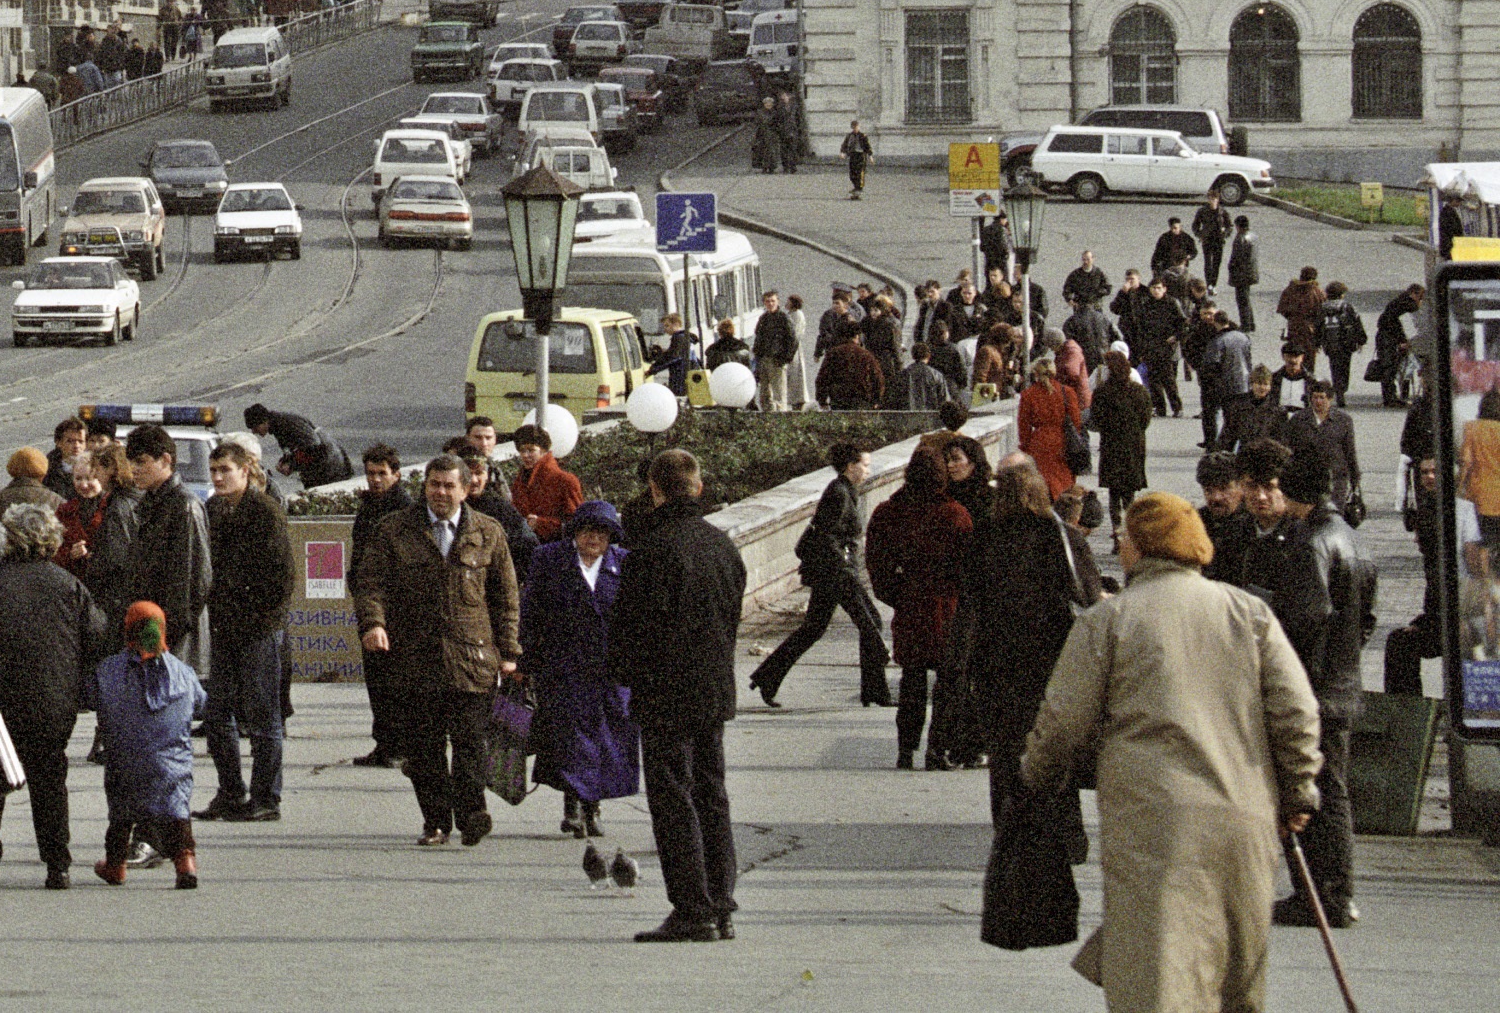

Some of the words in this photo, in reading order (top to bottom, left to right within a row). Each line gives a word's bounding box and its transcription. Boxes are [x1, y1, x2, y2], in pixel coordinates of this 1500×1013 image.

[964, 144, 984, 168] А
[308, 580, 337, 590] ISABELLE
[290, 636, 348, 651] ЕТИКА
[292, 662, 363, 677] АНЦИИ
